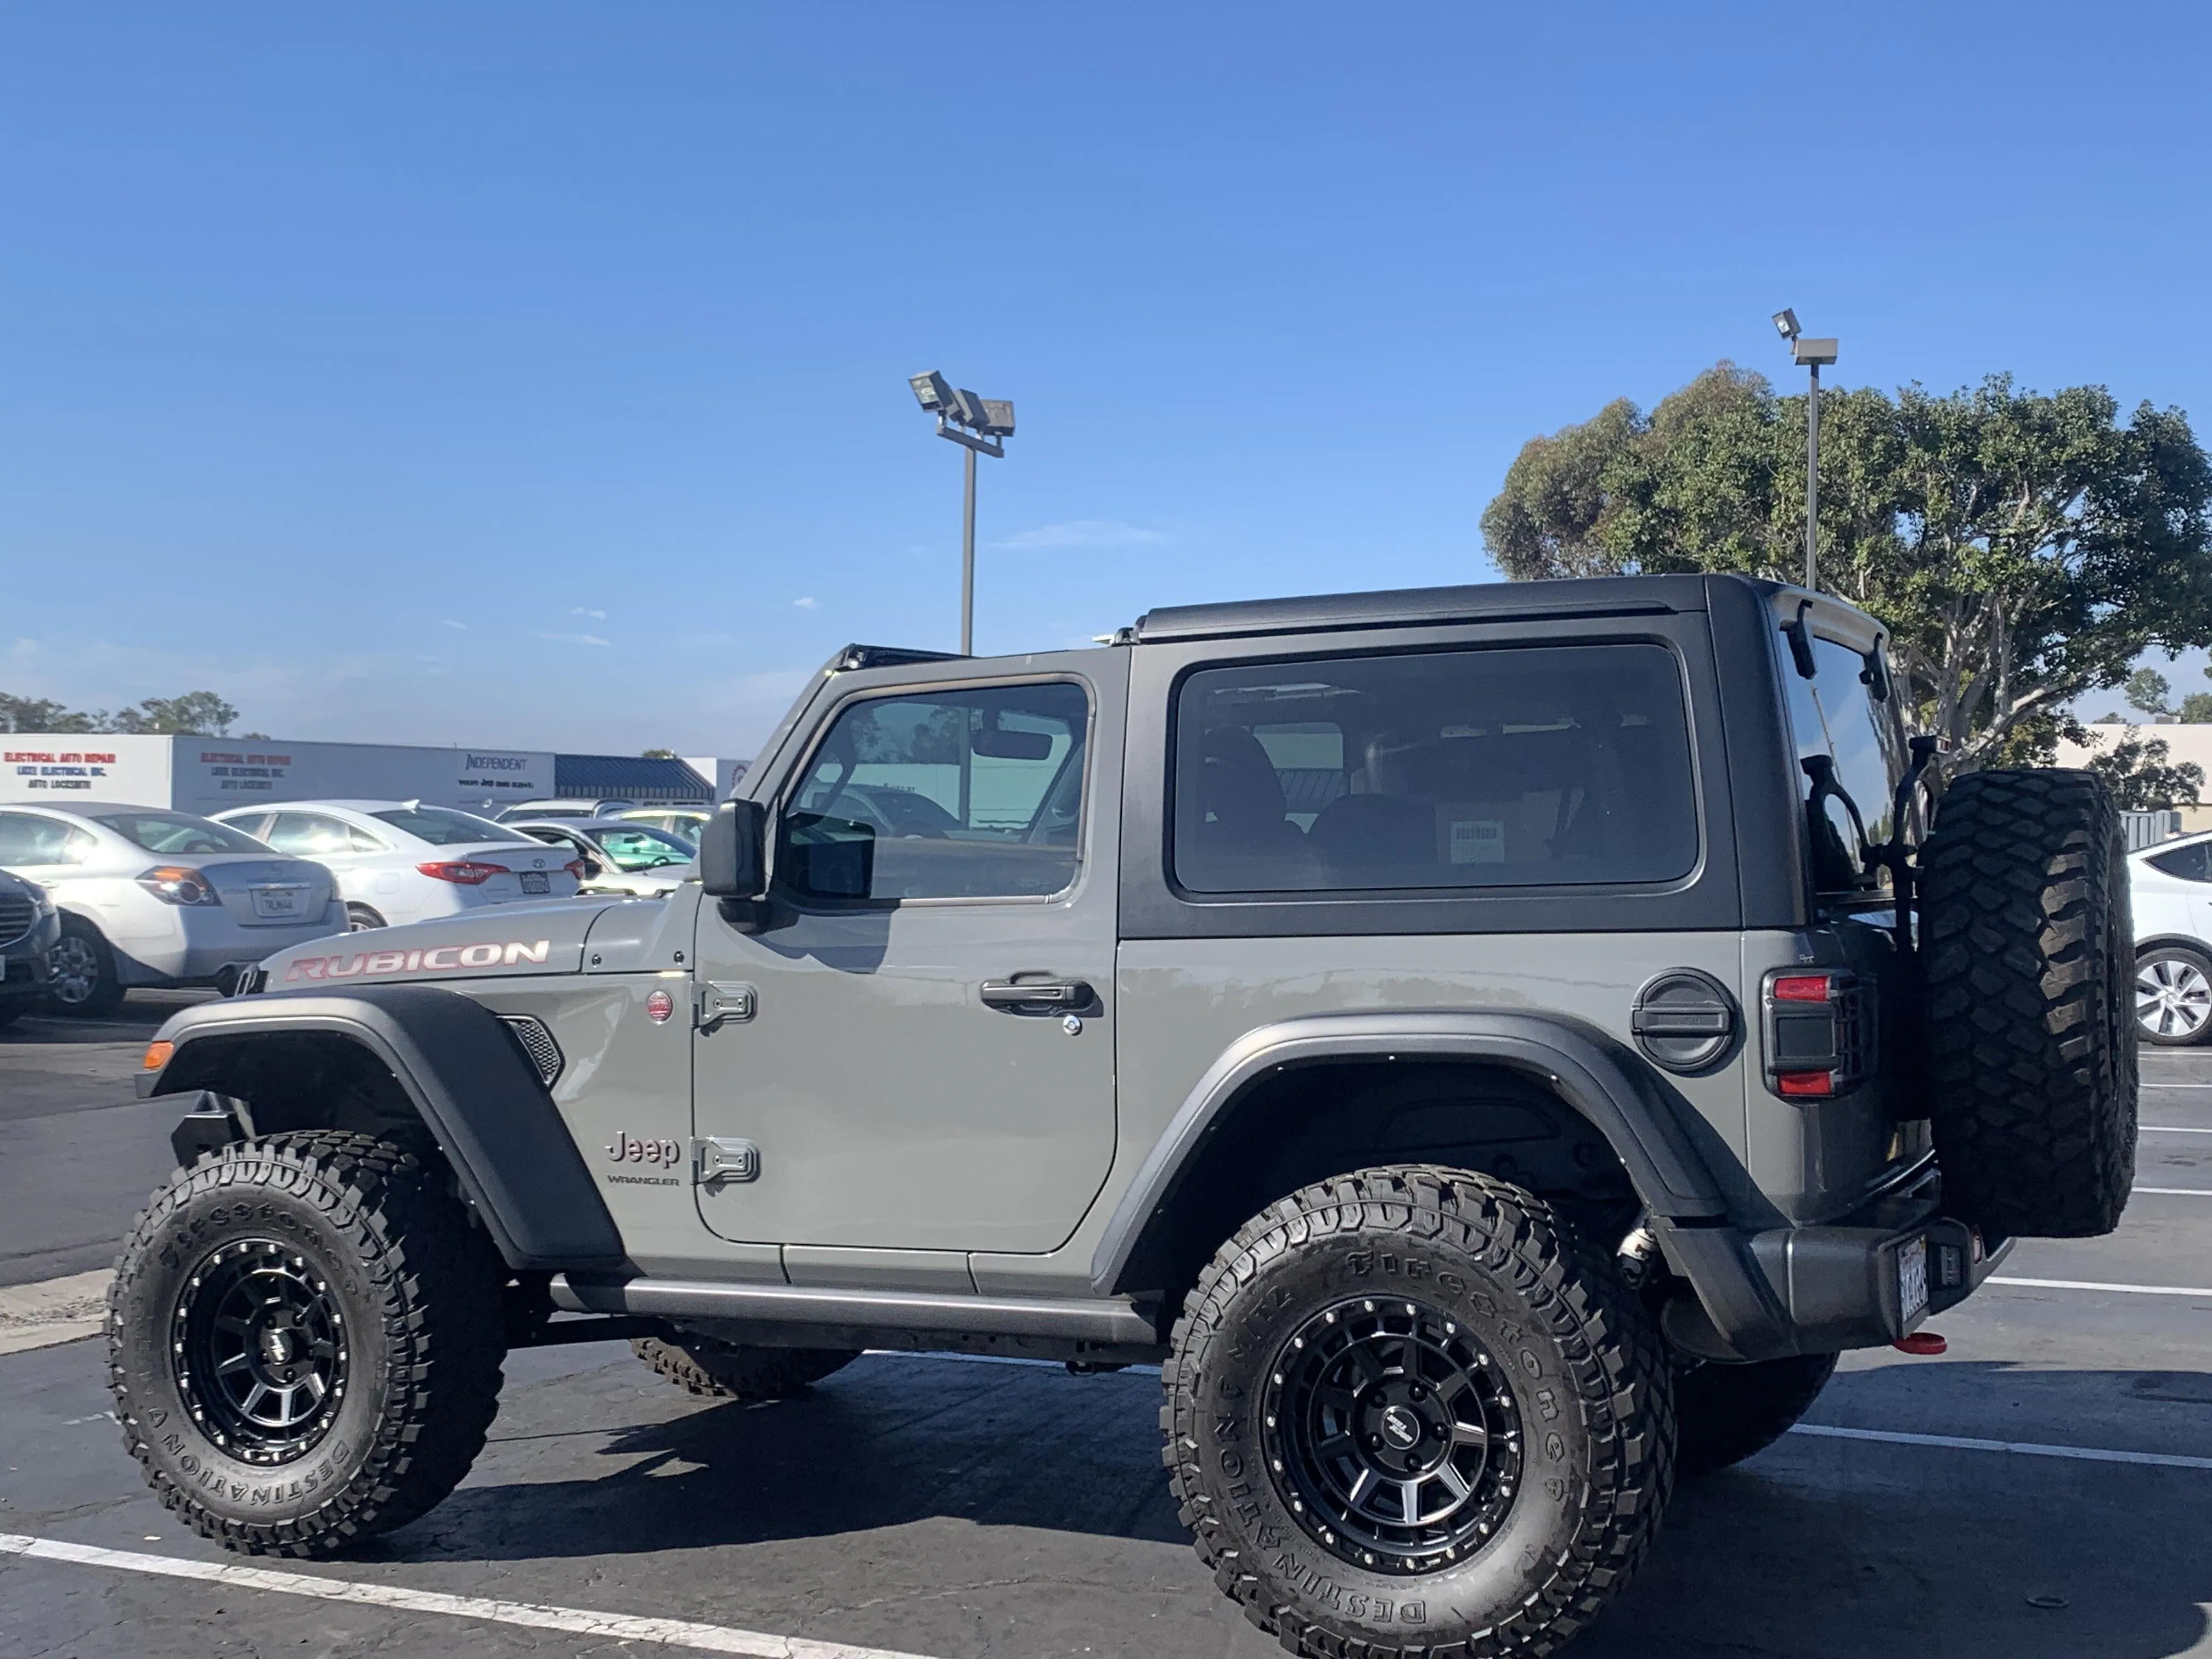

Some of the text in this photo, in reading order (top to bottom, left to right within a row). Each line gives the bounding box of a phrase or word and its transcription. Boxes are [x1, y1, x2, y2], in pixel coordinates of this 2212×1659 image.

[4, 752, 116, 764] ELECTRICAL AUTO REPAIR
[466, 753, 528, 771] INDEPENDENT
[285, 940, 550, 982] RUBICON
[605, 1130, 680, 1170] Jeep
[607, 1175, 680, 1186] WRANGLER
[161, 1433, 351, 1506] DESTINATION
[1214, 1413, 1426, 1625] DESTINATION
